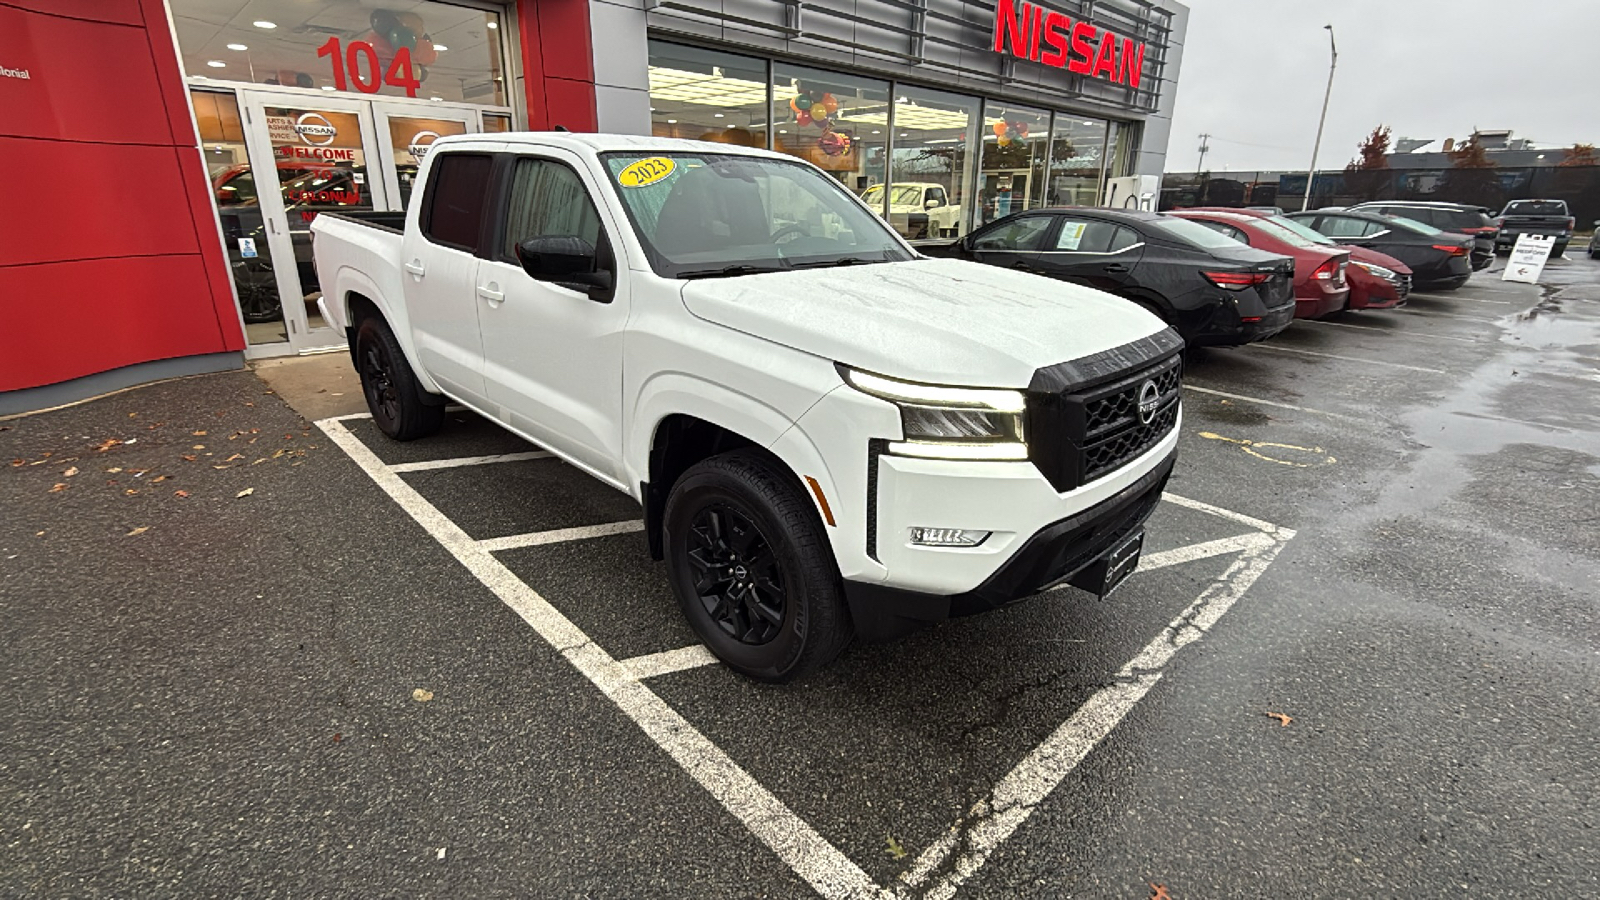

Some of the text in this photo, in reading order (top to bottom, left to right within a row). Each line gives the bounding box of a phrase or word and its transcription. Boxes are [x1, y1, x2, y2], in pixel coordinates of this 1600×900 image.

[995, 0, 1145, 88] NISSAN
[0, 65, 31, 80] lonial
[316, 36, 421, 98] 104
[269, 132, 291, 140] RVICE
[298, 126, 334, 135] NISSAN
[281, 146, 355, 160] WELCOME
[412, 146, 429, 154] NIS
[312, 169, 334, 181] TO
[629, 159, 668, 184] 2023
